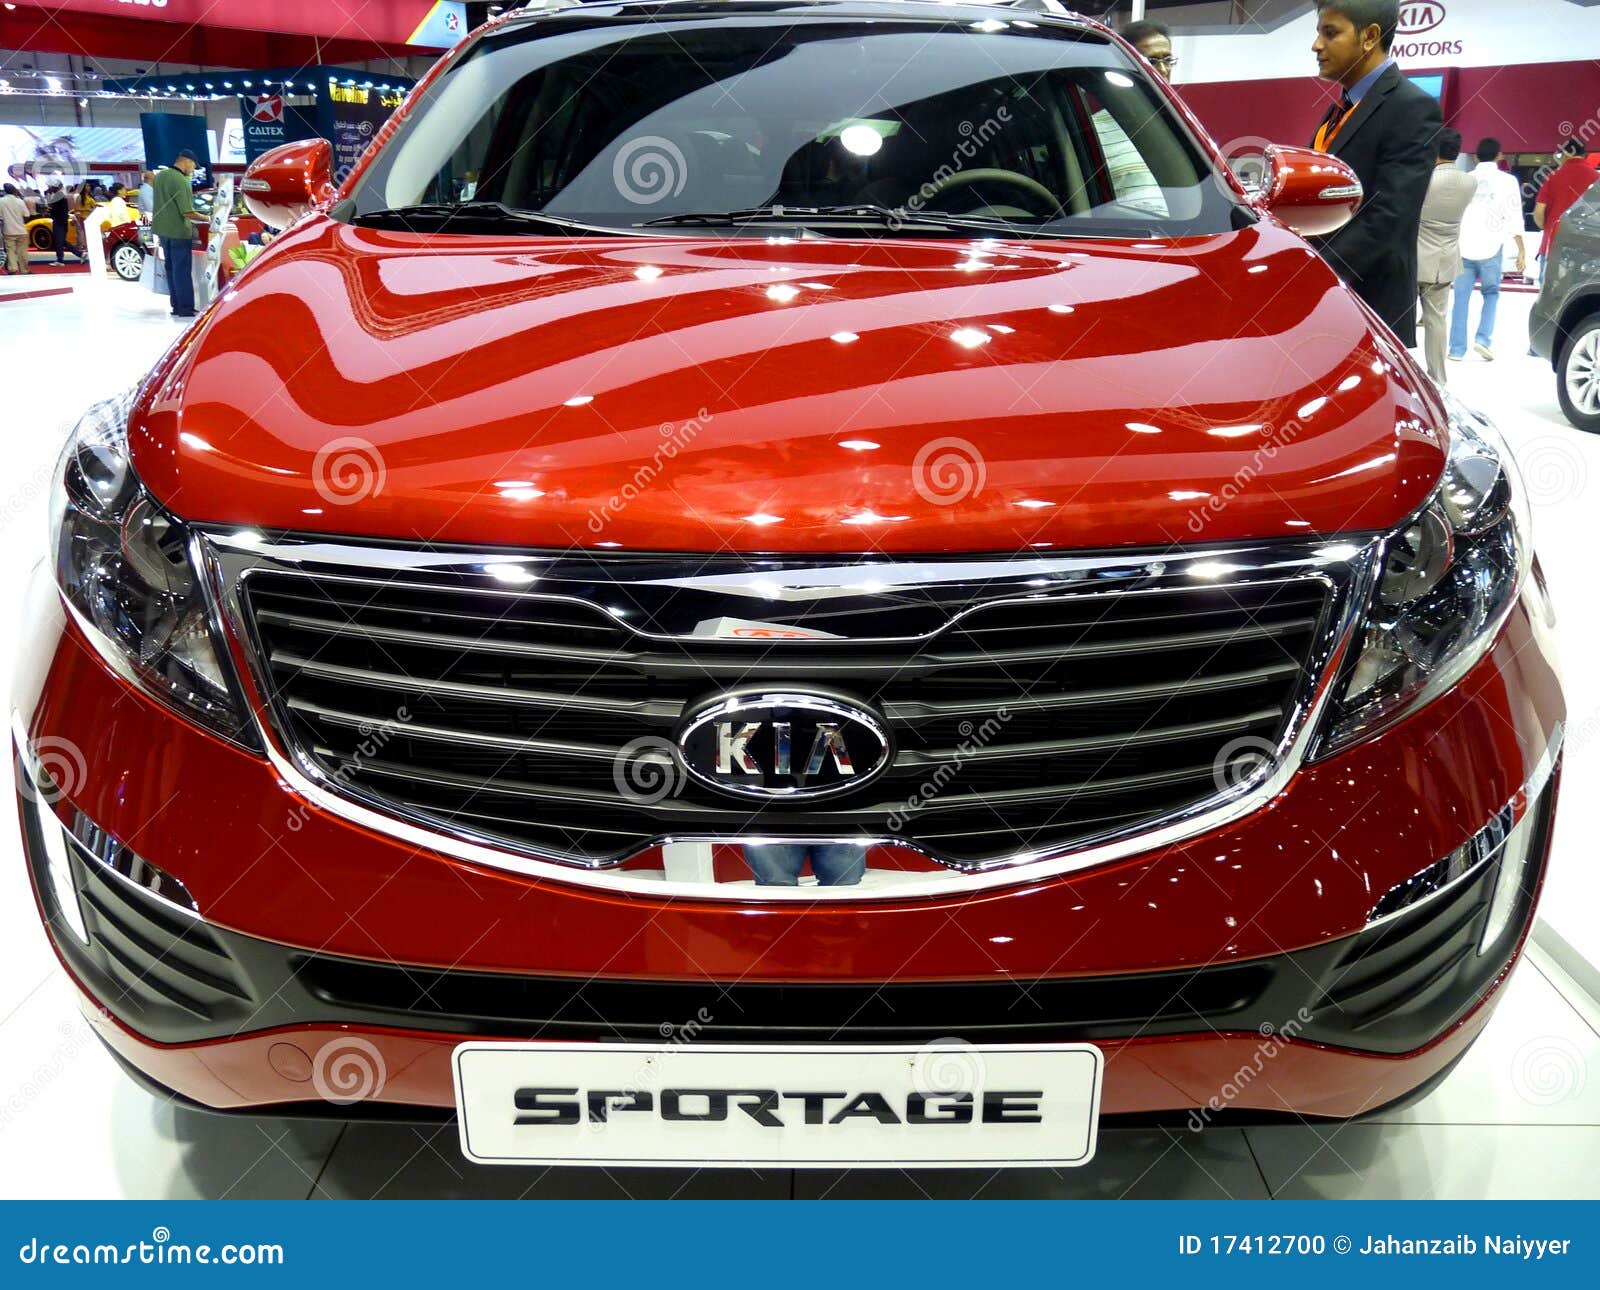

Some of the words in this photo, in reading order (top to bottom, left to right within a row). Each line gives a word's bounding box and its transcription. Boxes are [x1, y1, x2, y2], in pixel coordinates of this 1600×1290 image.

[1391, 40, 1463, 57] MOTORS
[248, 126, 285, 136] CALTEX
[714, 722, 856, 775] KIA
[513, 1087, 1044, 1127] SPORTAGE
